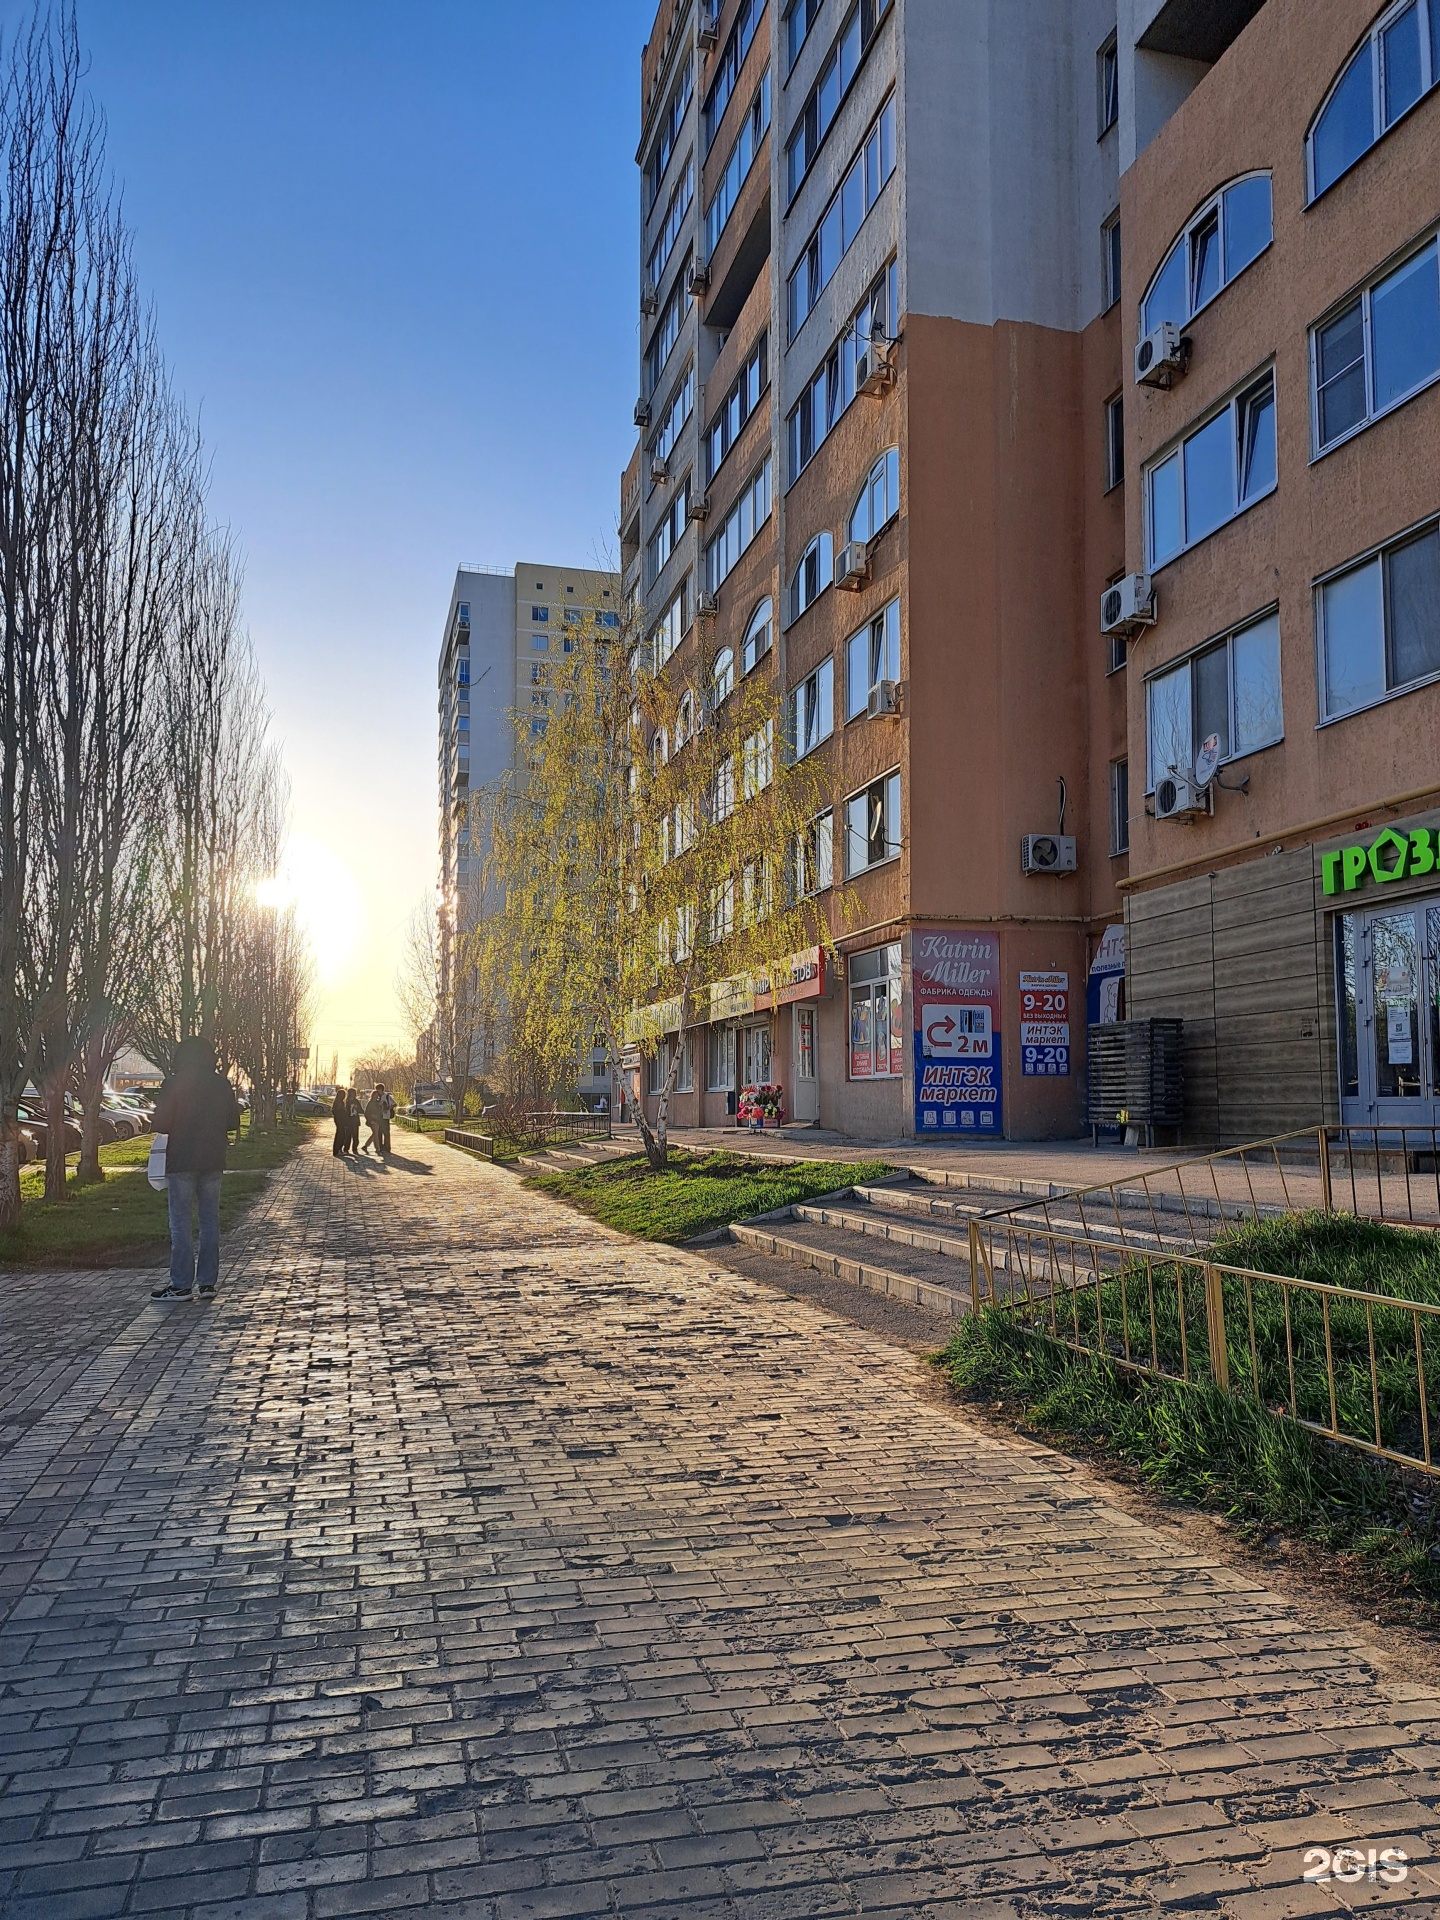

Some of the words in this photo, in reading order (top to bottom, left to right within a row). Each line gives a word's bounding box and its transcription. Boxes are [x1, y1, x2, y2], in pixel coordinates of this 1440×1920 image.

[1321, 827, 1440, 896] ГРОЗ
[920, 935, 993, 959] Katrin
[1095, 937, 1125, 959] НТЭ
[921, 960, 991, 984] Miller
[920, 987, 957, 996] ФАБРИКА
[958, 988, 993, 998] ОДЕЖДЫ
[1023, 994, 1066, 1012] 9-20
[1027, 1025, 1064, 1036] ИНТЭК
[957, 1035, 969, 1053] 2
[1025, 1036, 1066, 1046] маркет
[1025, 1047, 1067, 1063] 9-20
[923, 1065, 993, 1086] ИНТЭК
[920, 1086, 998, 1107] маркет
